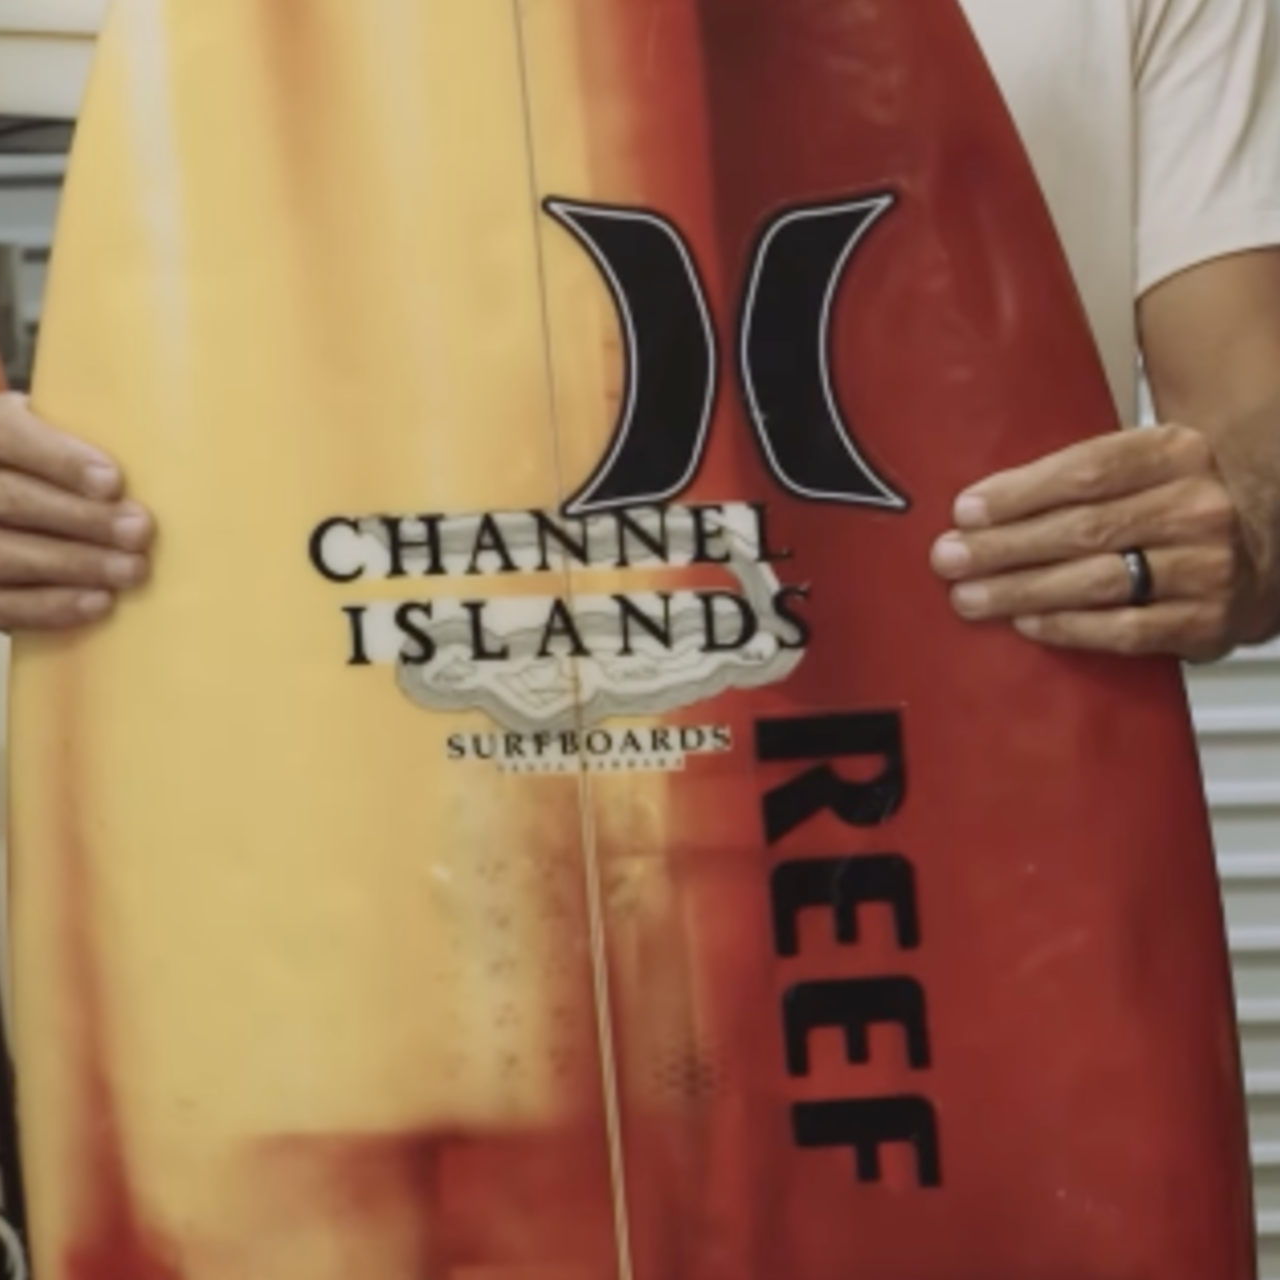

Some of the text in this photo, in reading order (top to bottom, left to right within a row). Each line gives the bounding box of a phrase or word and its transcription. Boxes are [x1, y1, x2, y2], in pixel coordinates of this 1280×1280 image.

[308, 504, 793, 583] CHANNEL
[341, 586, 811, 667] ISLANDS
[446, 726, 733, 759] SURFBOARDS
[754, 709, 941, 1188] REEF
